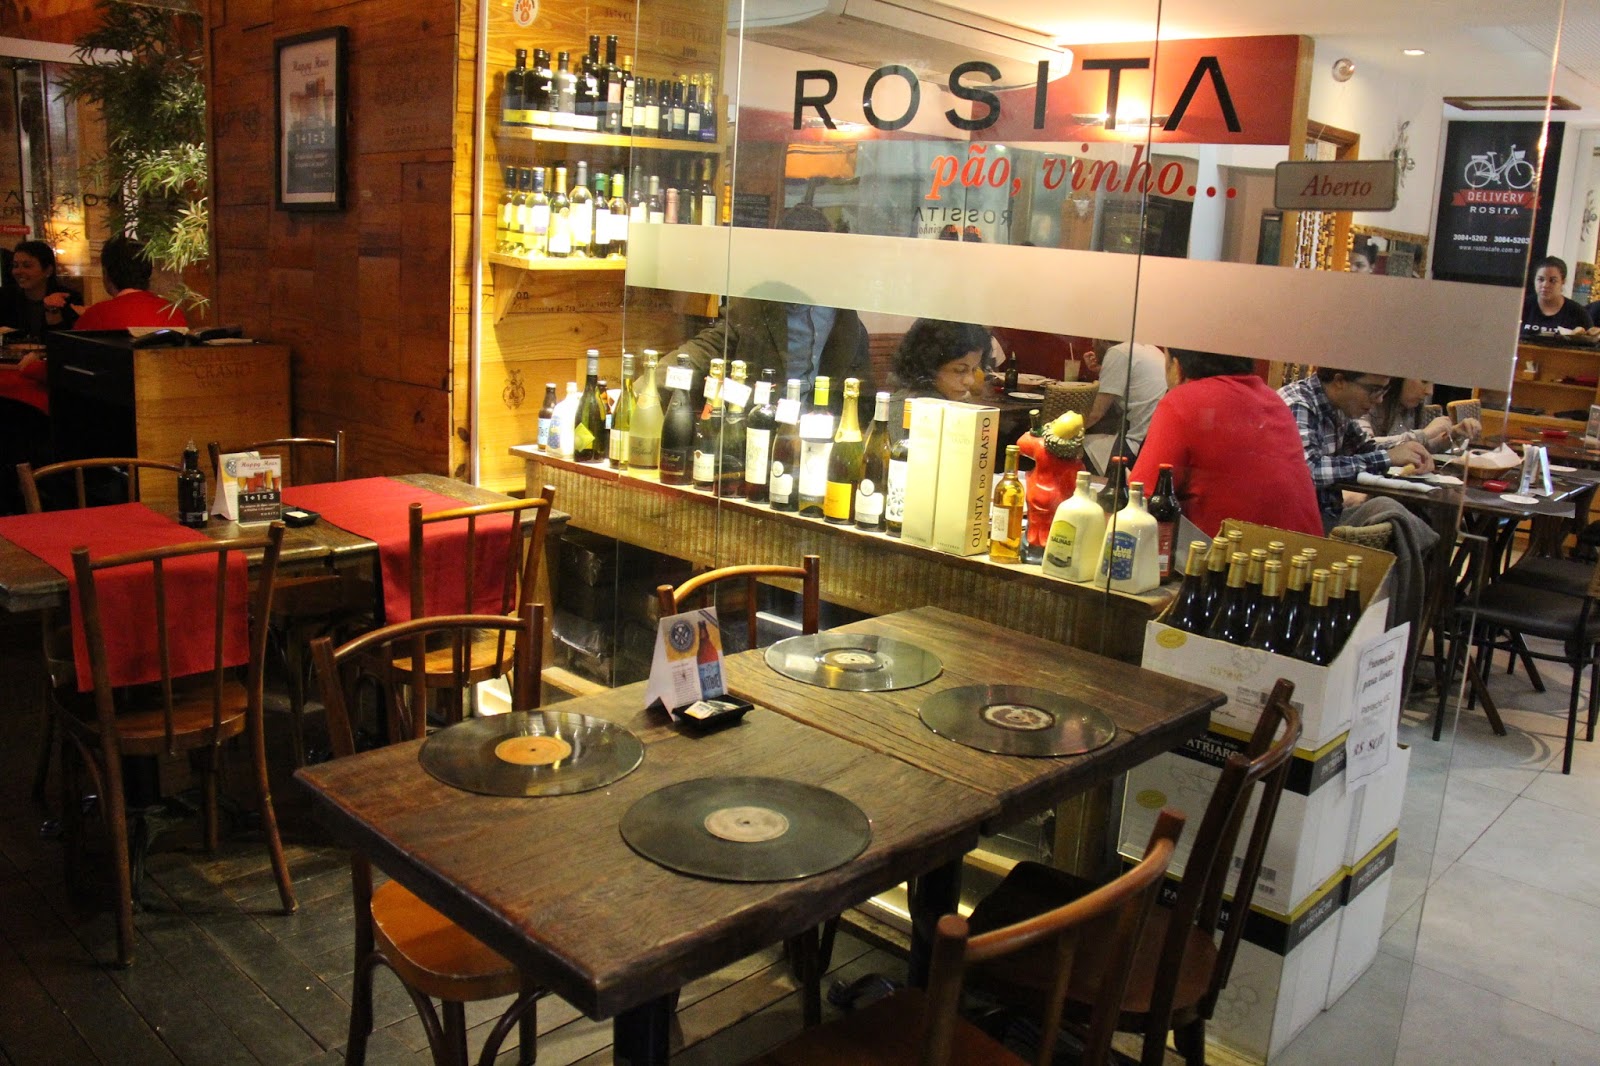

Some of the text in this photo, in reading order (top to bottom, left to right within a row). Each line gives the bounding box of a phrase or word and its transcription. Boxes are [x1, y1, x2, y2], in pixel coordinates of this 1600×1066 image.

[792, 55, 1242, 133] ROSITA
[924, 144, 1022, 200] pão,
[1300, 174, 1372, 197] Aberto
[1467, 191, 1525, 203] DELIVERY
[1469, 206, 1519, 215] ROSITA
[1524, 323, 1560, 334] ROSIT
[971, 417, 991, 548] QUINTA DO CRASTO
